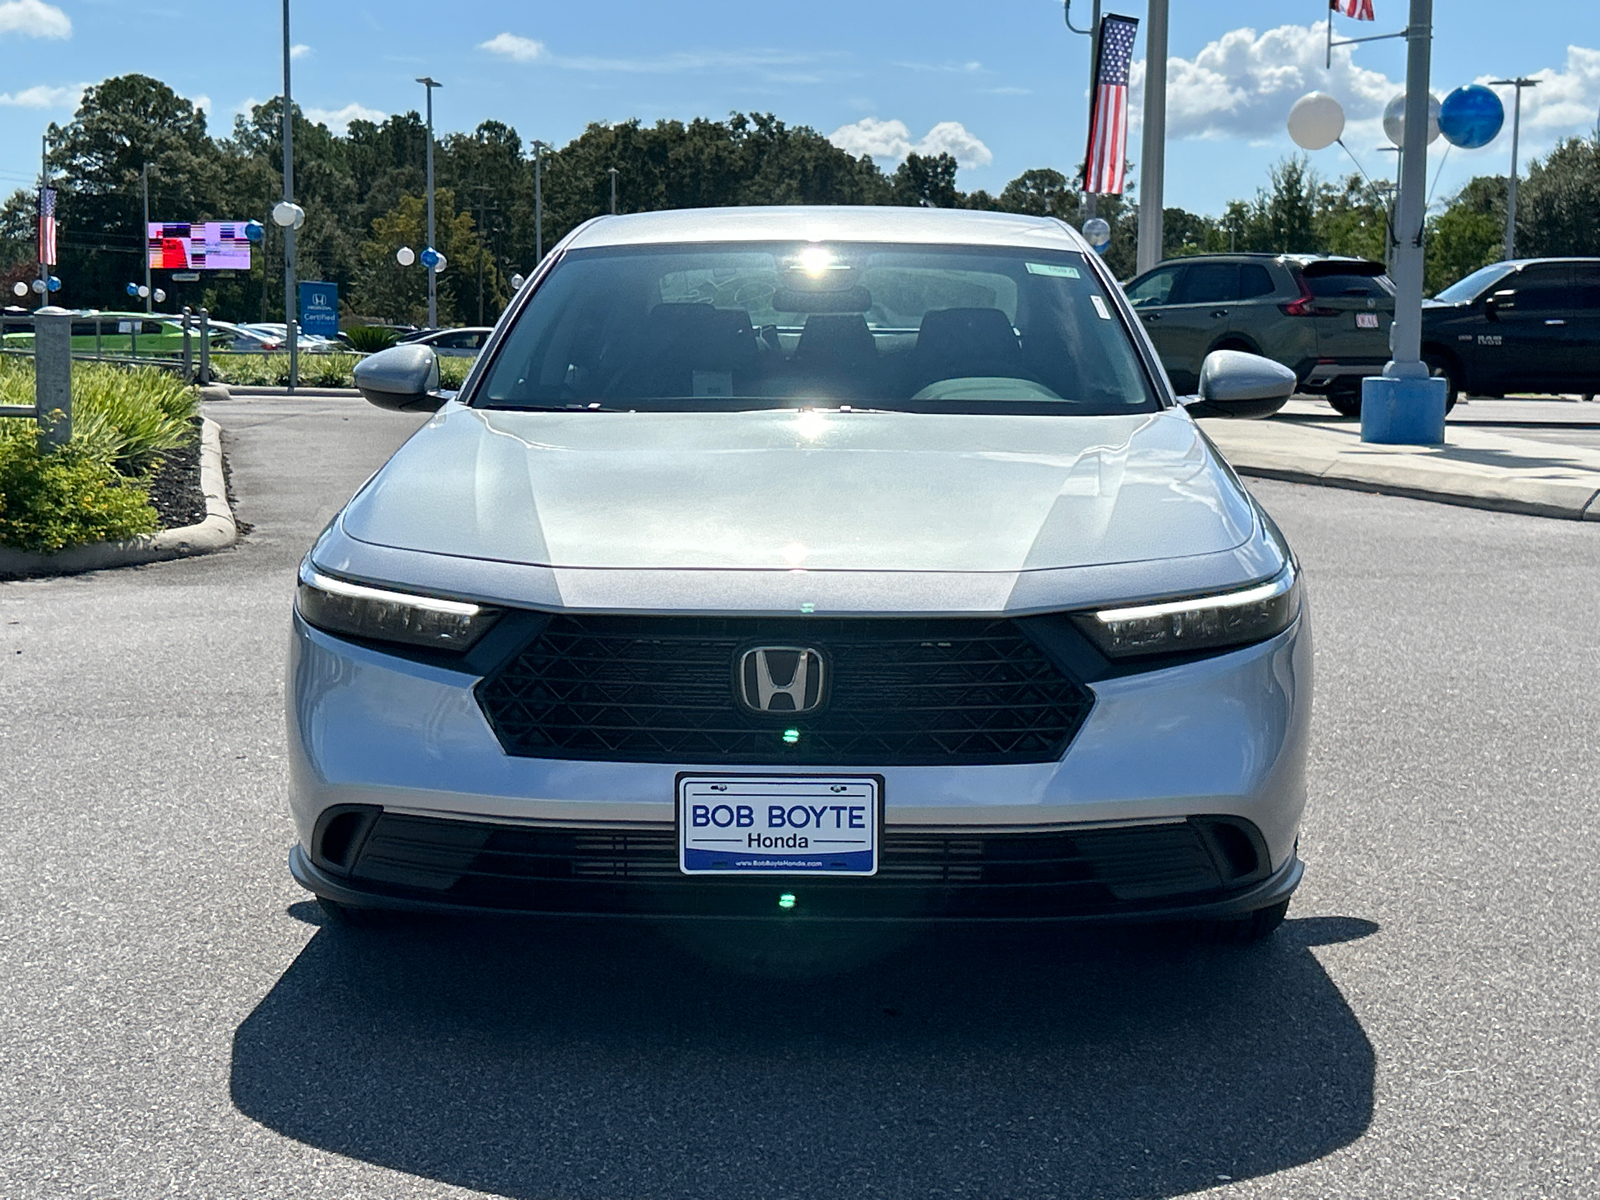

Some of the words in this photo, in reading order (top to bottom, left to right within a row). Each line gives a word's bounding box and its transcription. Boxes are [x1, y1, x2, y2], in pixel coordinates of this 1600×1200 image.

[304, 313, 336, 321] Certified
[692, 804, 754, 828] BOB
[768, 805, 866, 829] BOYTE
[748, 833, 809, 848] Honda
[735, 860, 823, 868] www.BobBoyteHonda.com
